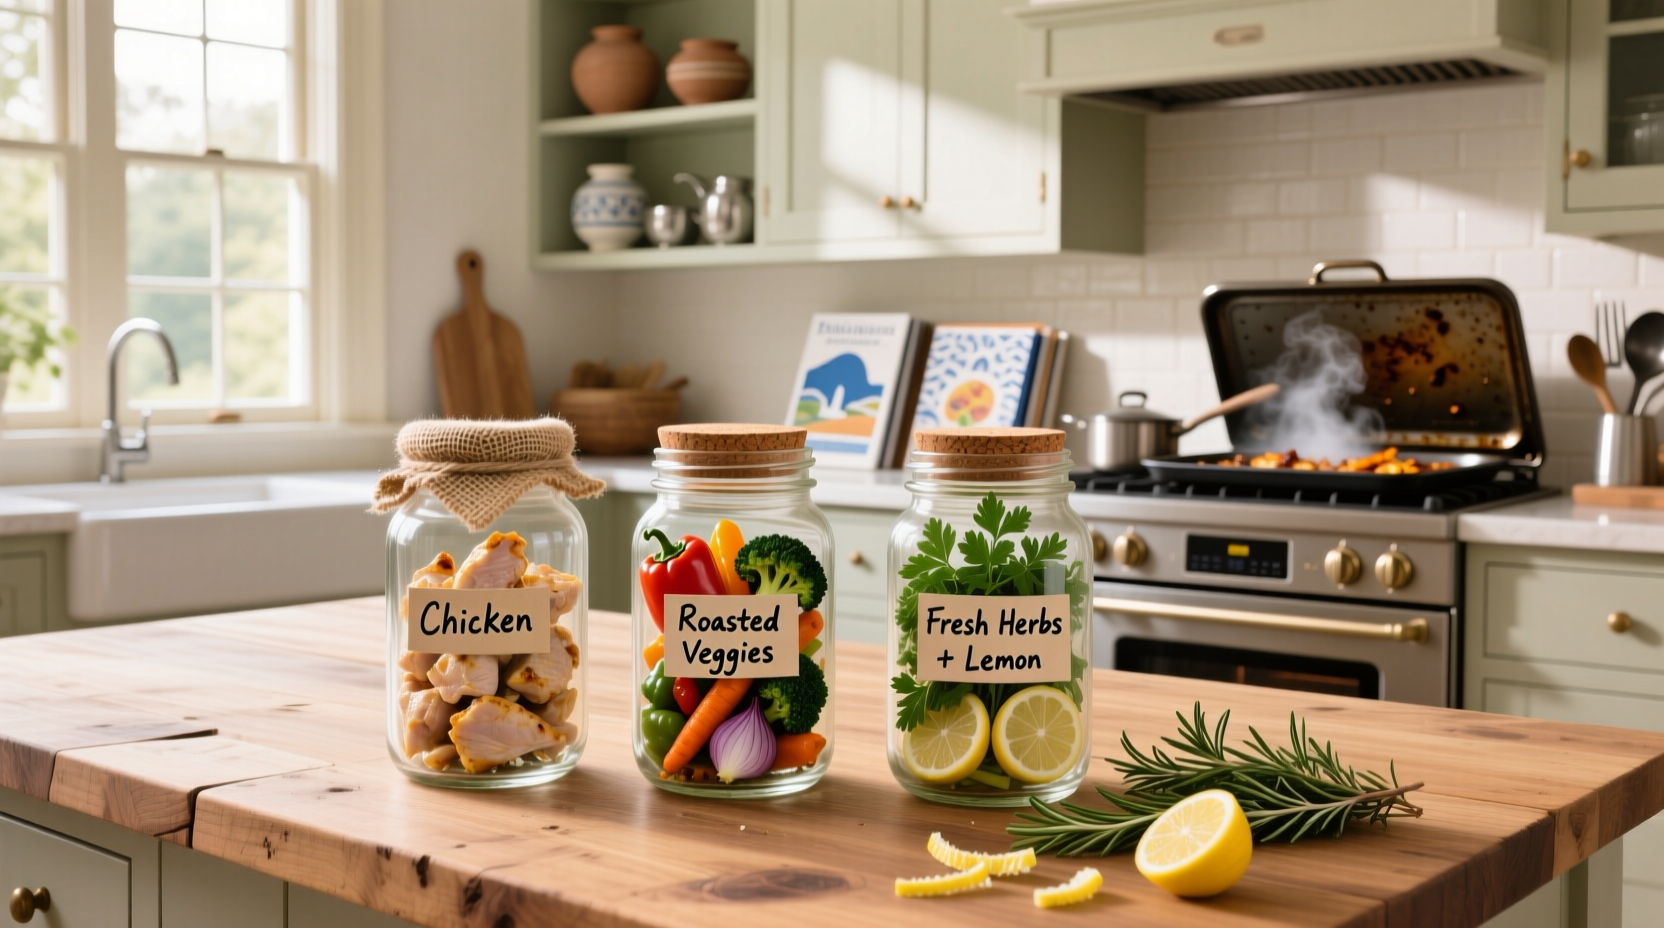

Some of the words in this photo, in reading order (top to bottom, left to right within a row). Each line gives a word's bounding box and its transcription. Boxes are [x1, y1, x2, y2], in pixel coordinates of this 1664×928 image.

[420, 601, 532, 636] Chicken
[679, 604, 780, 632] Roasted
[927, 606, 988, 636] Fresh
[999, 607, 1063, 636] Herbs
[682, 639, 774, 674] Veggies
[937, 650, 954, 669] +
[965, 645, 1042, 671] Lemon
